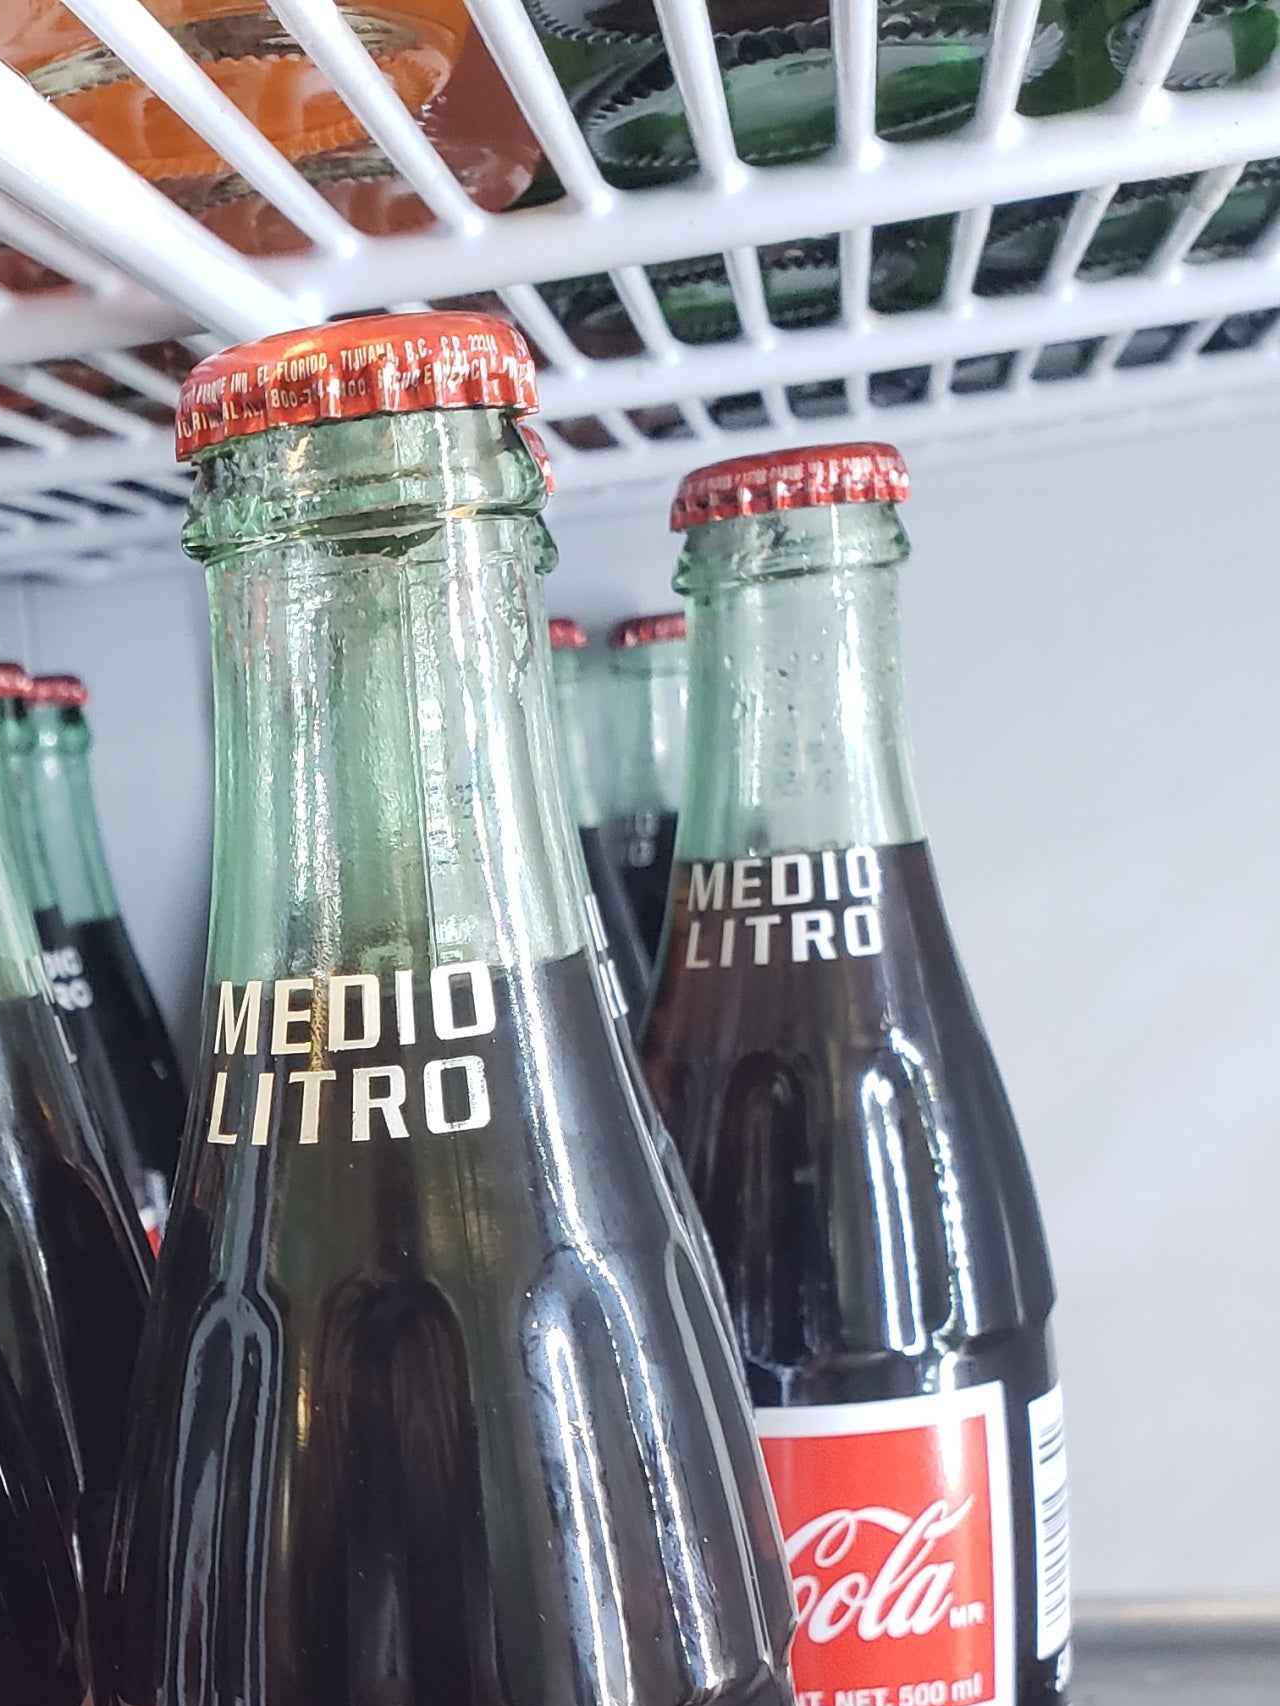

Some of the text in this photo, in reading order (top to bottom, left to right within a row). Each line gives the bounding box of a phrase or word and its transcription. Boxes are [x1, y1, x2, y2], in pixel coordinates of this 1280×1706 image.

[687, 844, 883, 914] MEDIO
[686, 903, 884, 970] LITRO
[214, 960, 498, 1056] MEDIO
[208, 1053, 491, 1146] LITRO
[951, 1671, 984, 1701] ml
